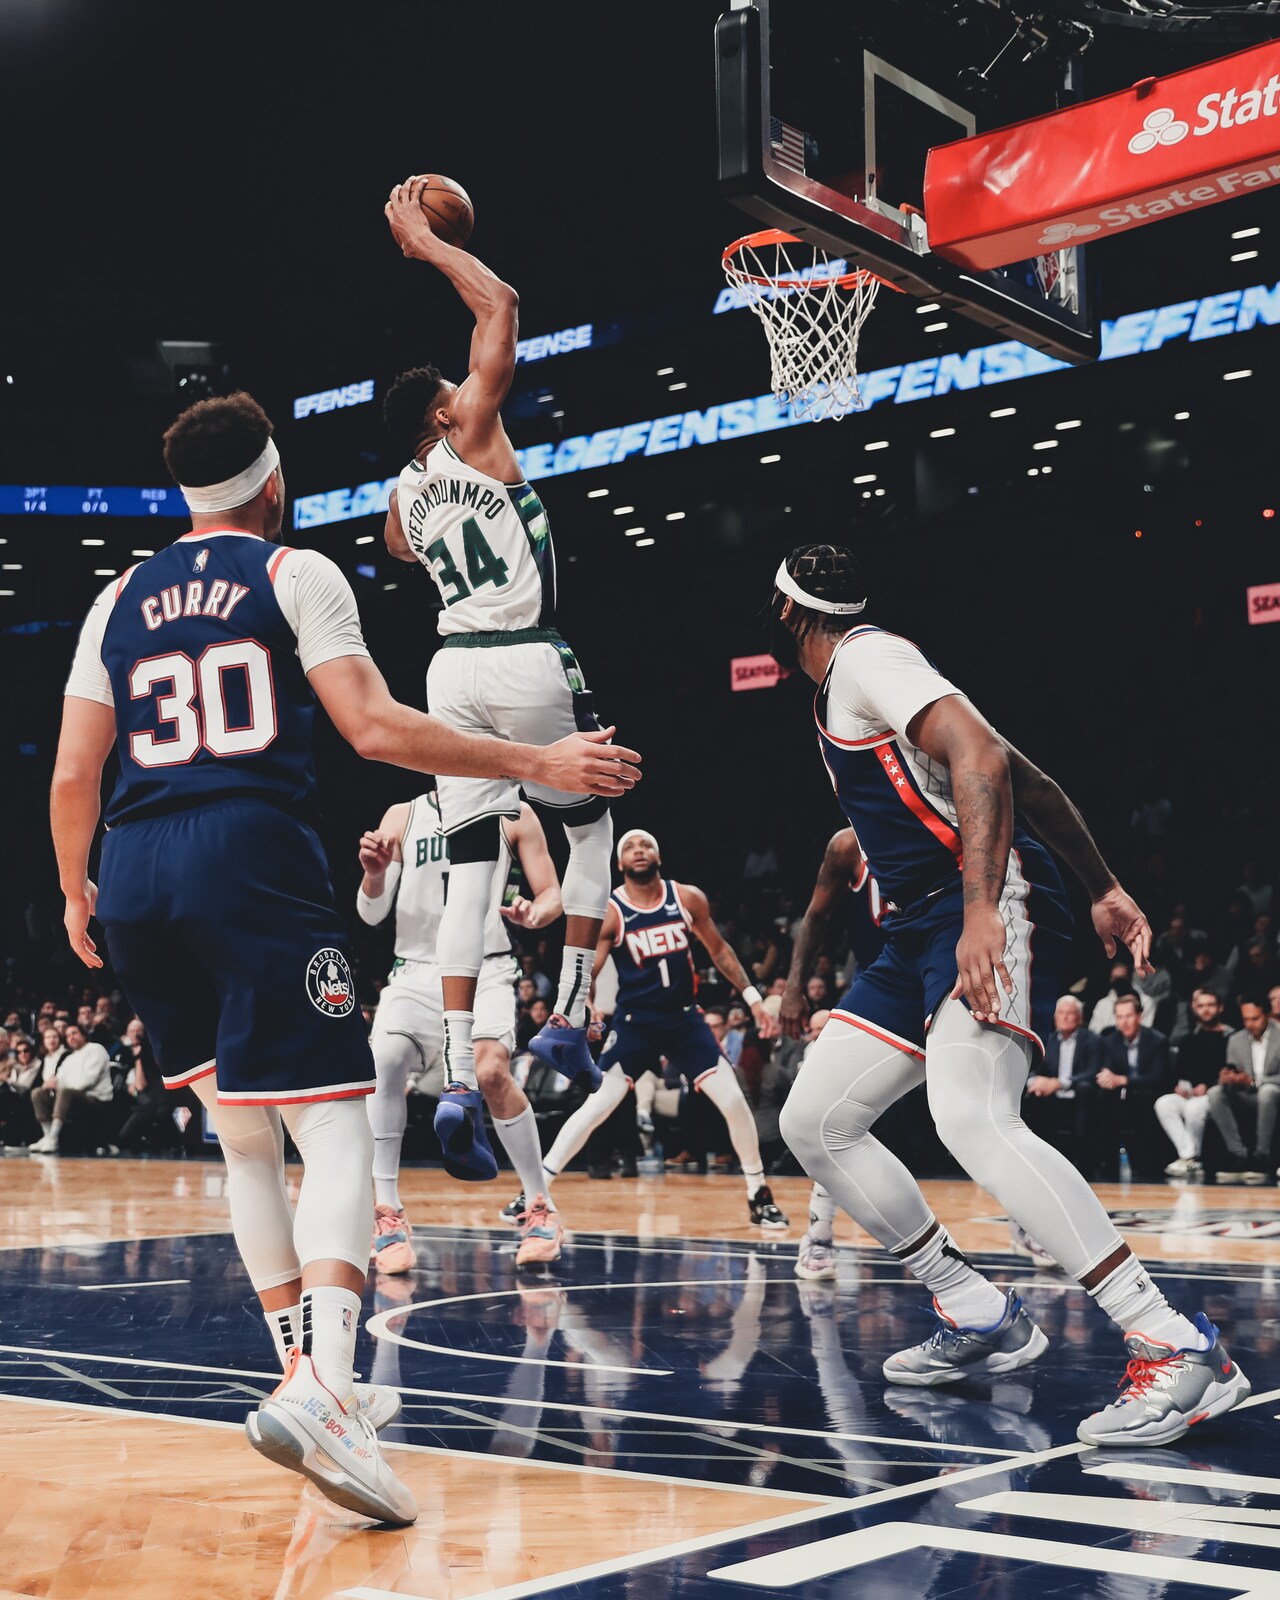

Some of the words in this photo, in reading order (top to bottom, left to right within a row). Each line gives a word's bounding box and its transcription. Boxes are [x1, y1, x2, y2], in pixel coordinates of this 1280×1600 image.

[1193, 74, 1280, 136] Stat
[1100, 186, 1218, 228] State
[23, 501, 47, 512] 1/4
[408, 479, 506, 566] NTETOKOUNMPO
[423, 516, 510, 608] 34
[140, 579, 251, 631] CURRY
[128, 637, 279, 769] 30
[309, 951, 350, 975] BROOKLYN
[625, 920, 689, 971] NETS
[320, 979, 348, 998] Nets
[657, 958, 671, 988] 1
[315, 996, 336, 1013] NEW
[325, 1418, 347, 1438] BOY
